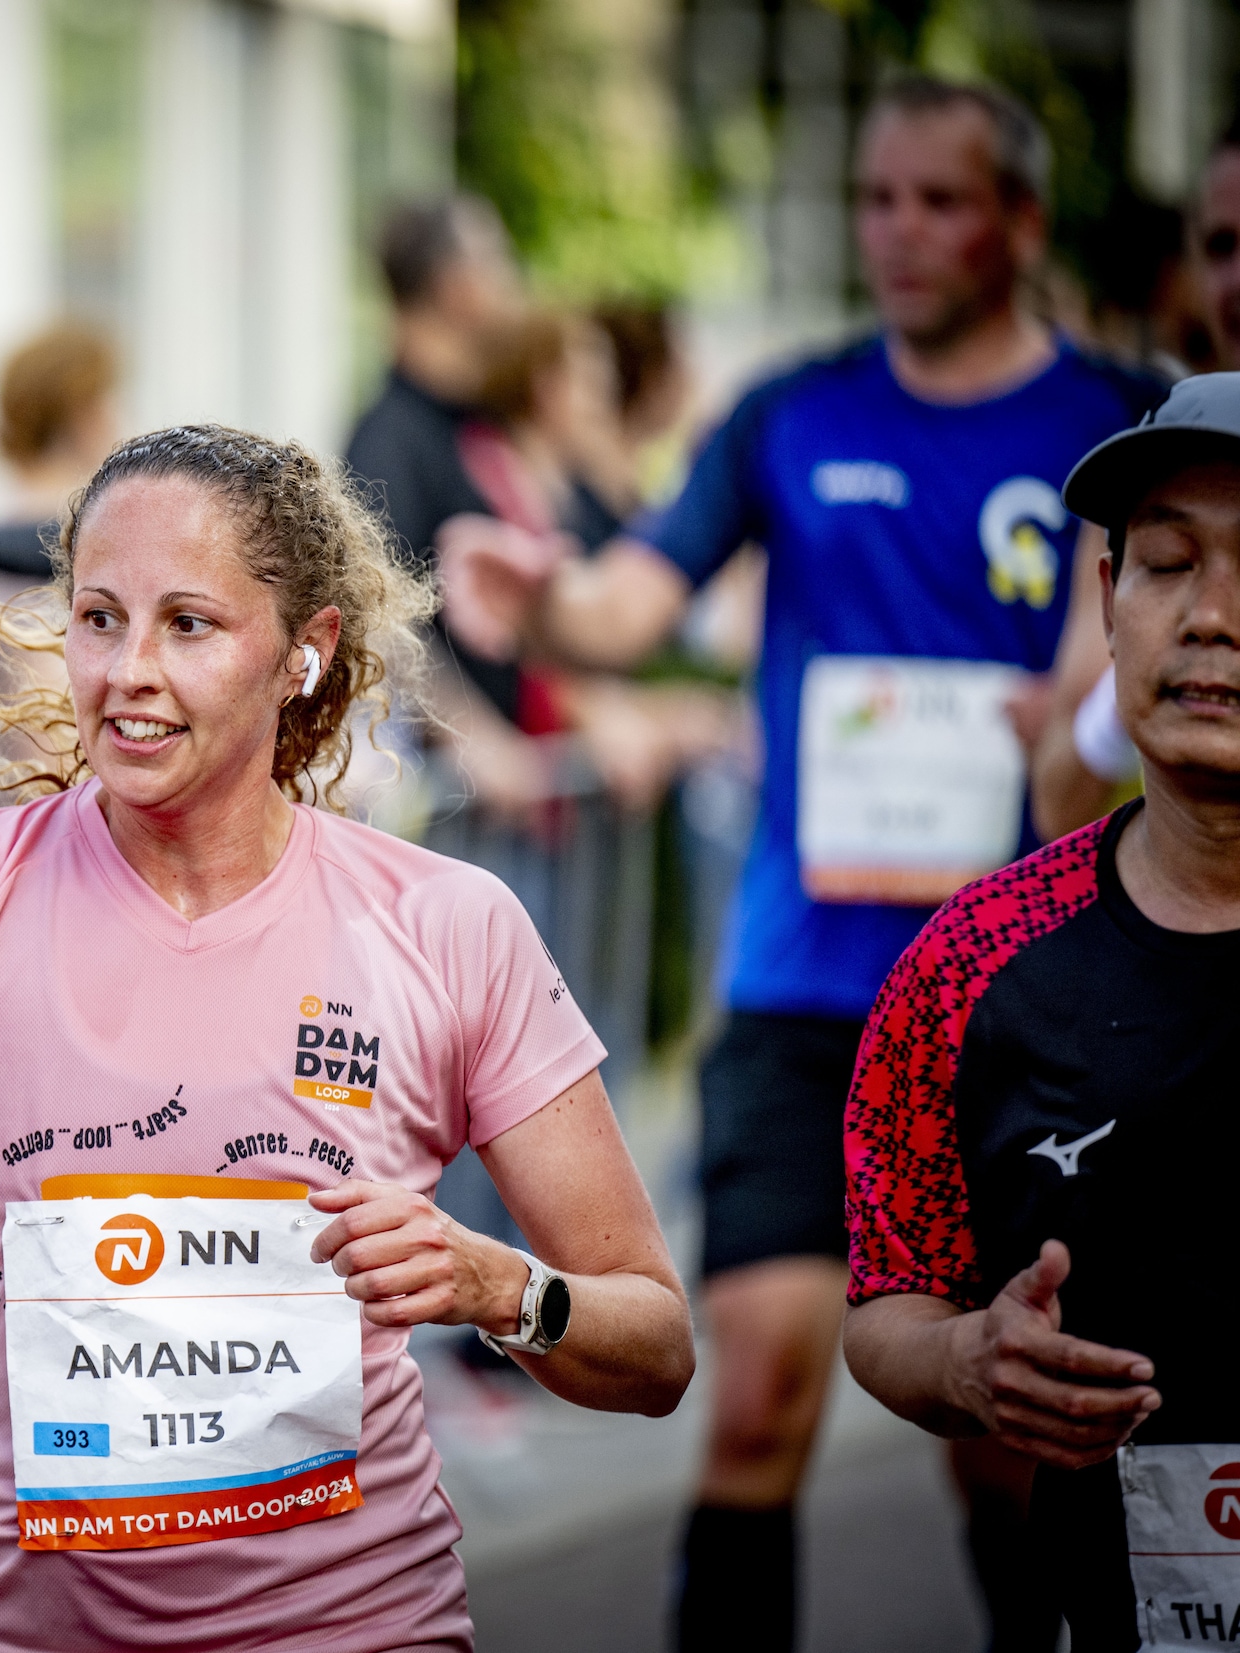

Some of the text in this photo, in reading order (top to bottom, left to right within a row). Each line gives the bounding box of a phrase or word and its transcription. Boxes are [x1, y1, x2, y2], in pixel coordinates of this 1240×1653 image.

[327, 1001, 352, 1017] NN
[297, 1023, 380, 1061] DAM
[315, 1085, 350, 1101] LOOP
[73, 1125, 112, 1150] loop
[132, 1099, 188, 1140] start
[2, 1128, 54, 1167] geniet
[224, 1132, 288, 1164] geniet
[309, 1138, 355, 1176] feest
[179, 1230, 259, 1266] NN
[66, 1340, 301, 1380] AMANDA
[53, 1429, 90, 1449] 393
[143, 1411, 225, 1447] 1113
[25, 1475, 353, 1540] NN DAM TOT DAMLOOP 2024
